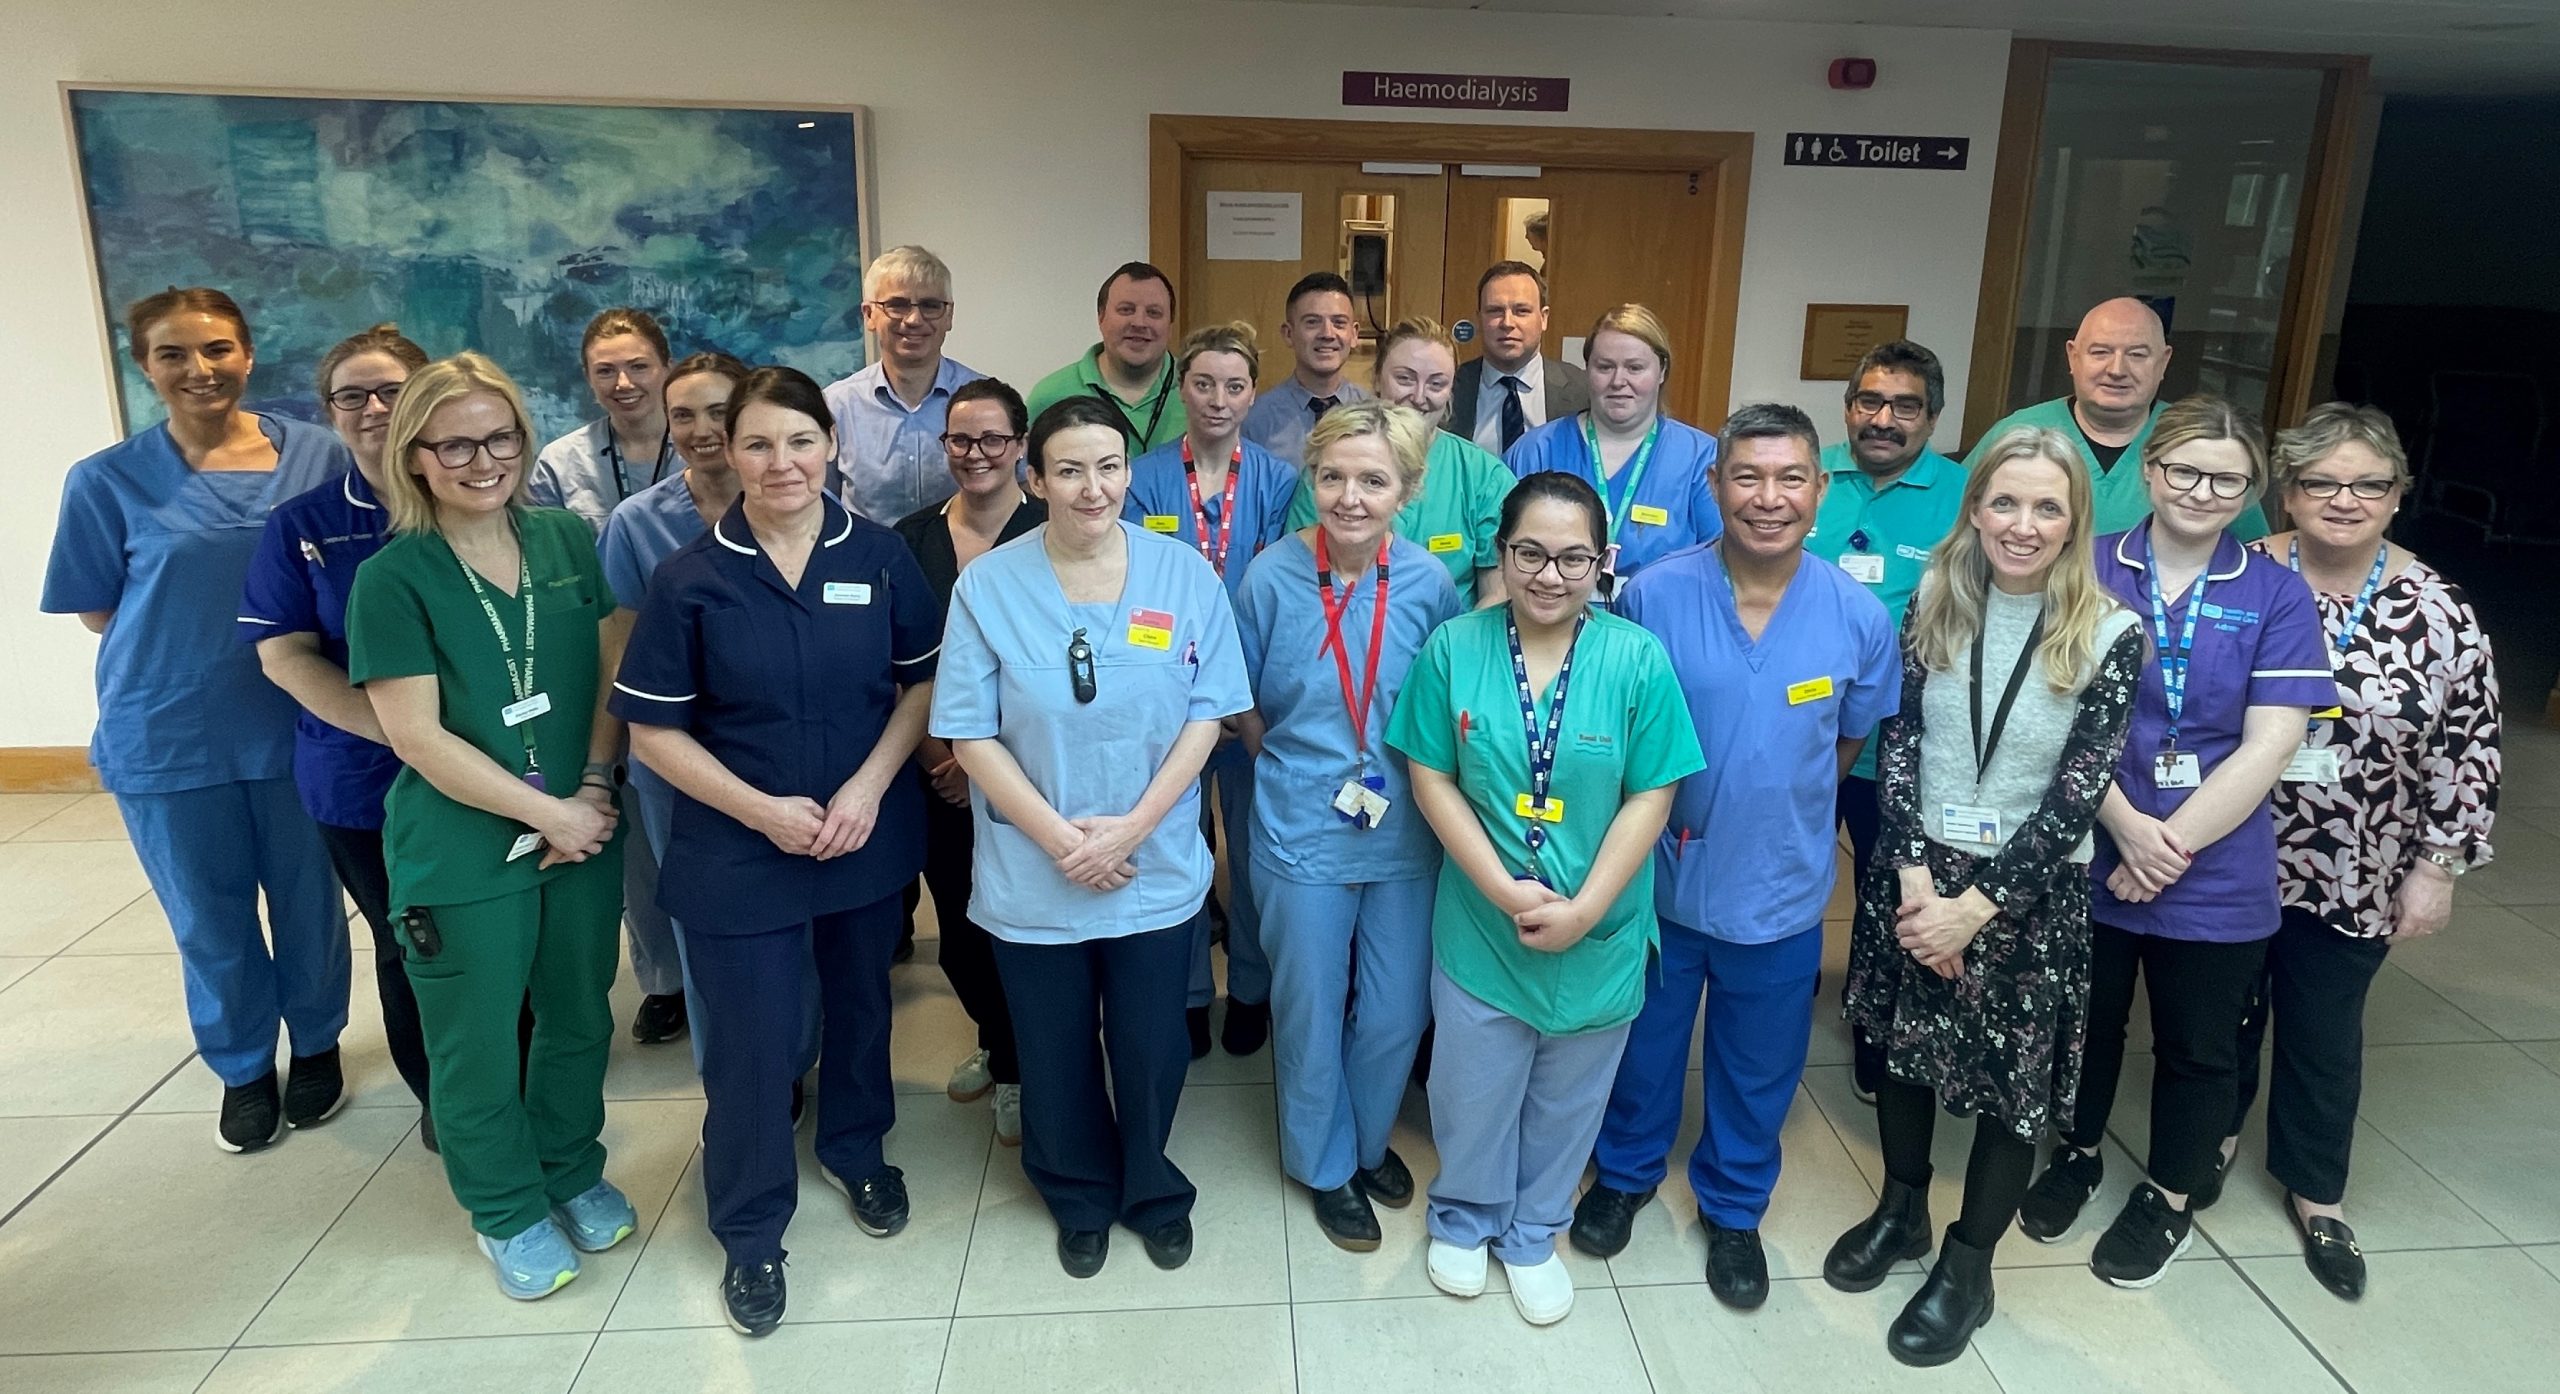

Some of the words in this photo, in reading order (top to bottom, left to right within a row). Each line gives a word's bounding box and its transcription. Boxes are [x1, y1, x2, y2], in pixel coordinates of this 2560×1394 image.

[1374, 76, 1538, 107] Haemodialysis
[1856, 140, 1921, 162] Toilet
[480, 599, 512, 653] PHARMACIST
[523, 594, 535, 652] PHARMACIST
[506, 658, 525, 701] ARMACIST
[523, 657, 534, 698] PHARMA
